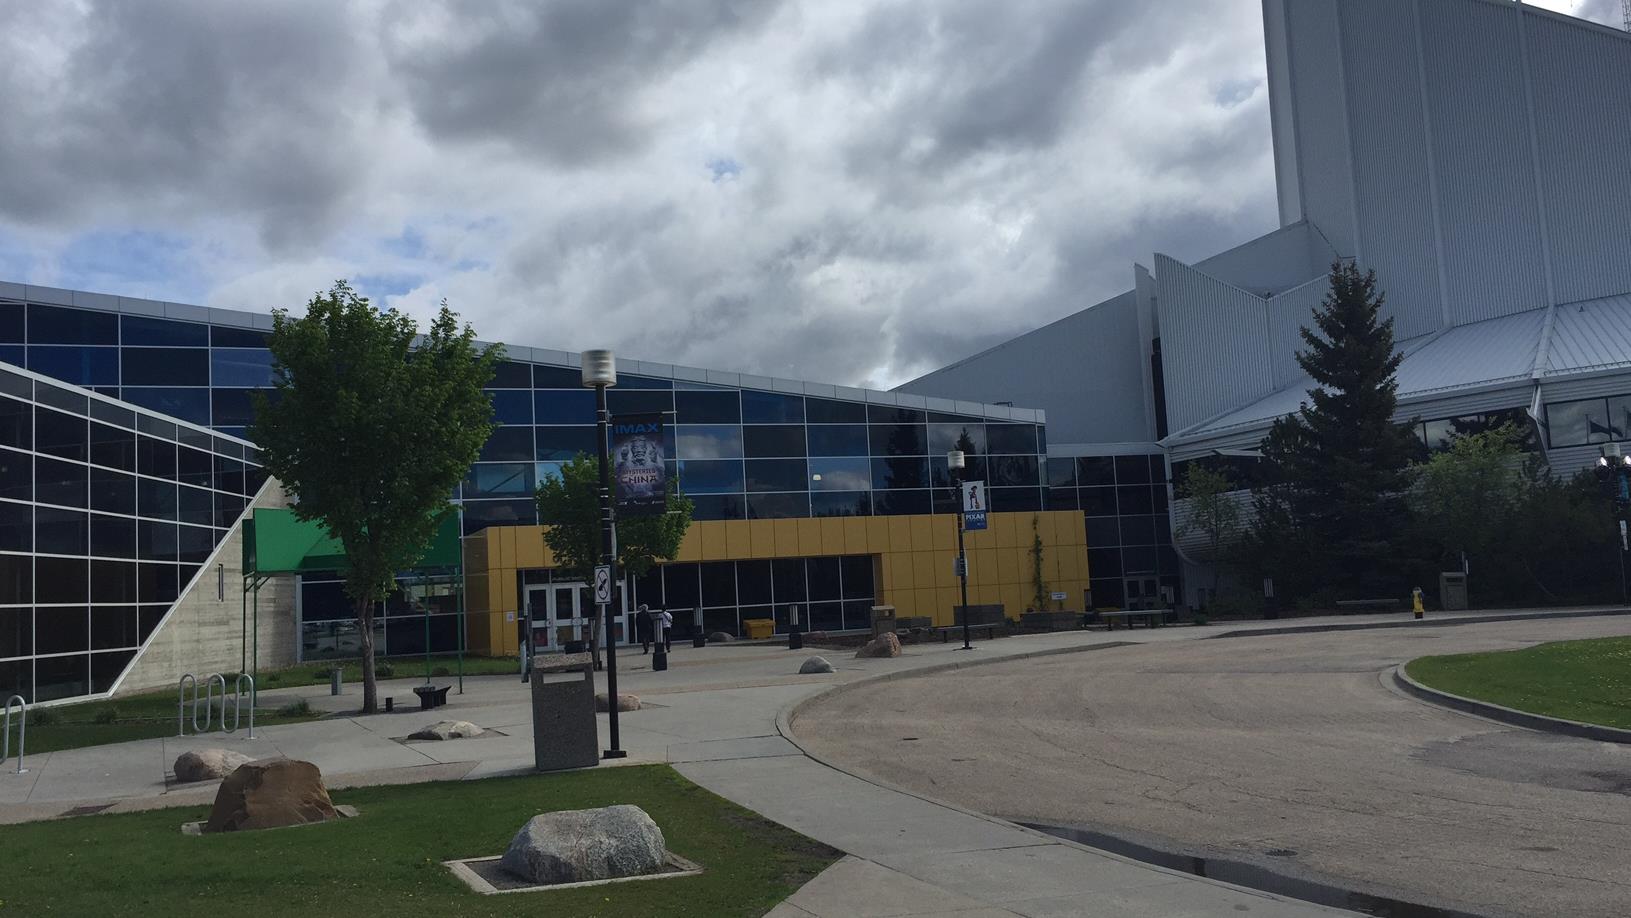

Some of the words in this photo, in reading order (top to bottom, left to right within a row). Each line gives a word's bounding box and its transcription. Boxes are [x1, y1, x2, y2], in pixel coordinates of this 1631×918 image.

[615, 423, 659, 434] IMAX
[620, 475, 657, 484] CHINA
[965, 513, 986, 521] PIXAR
